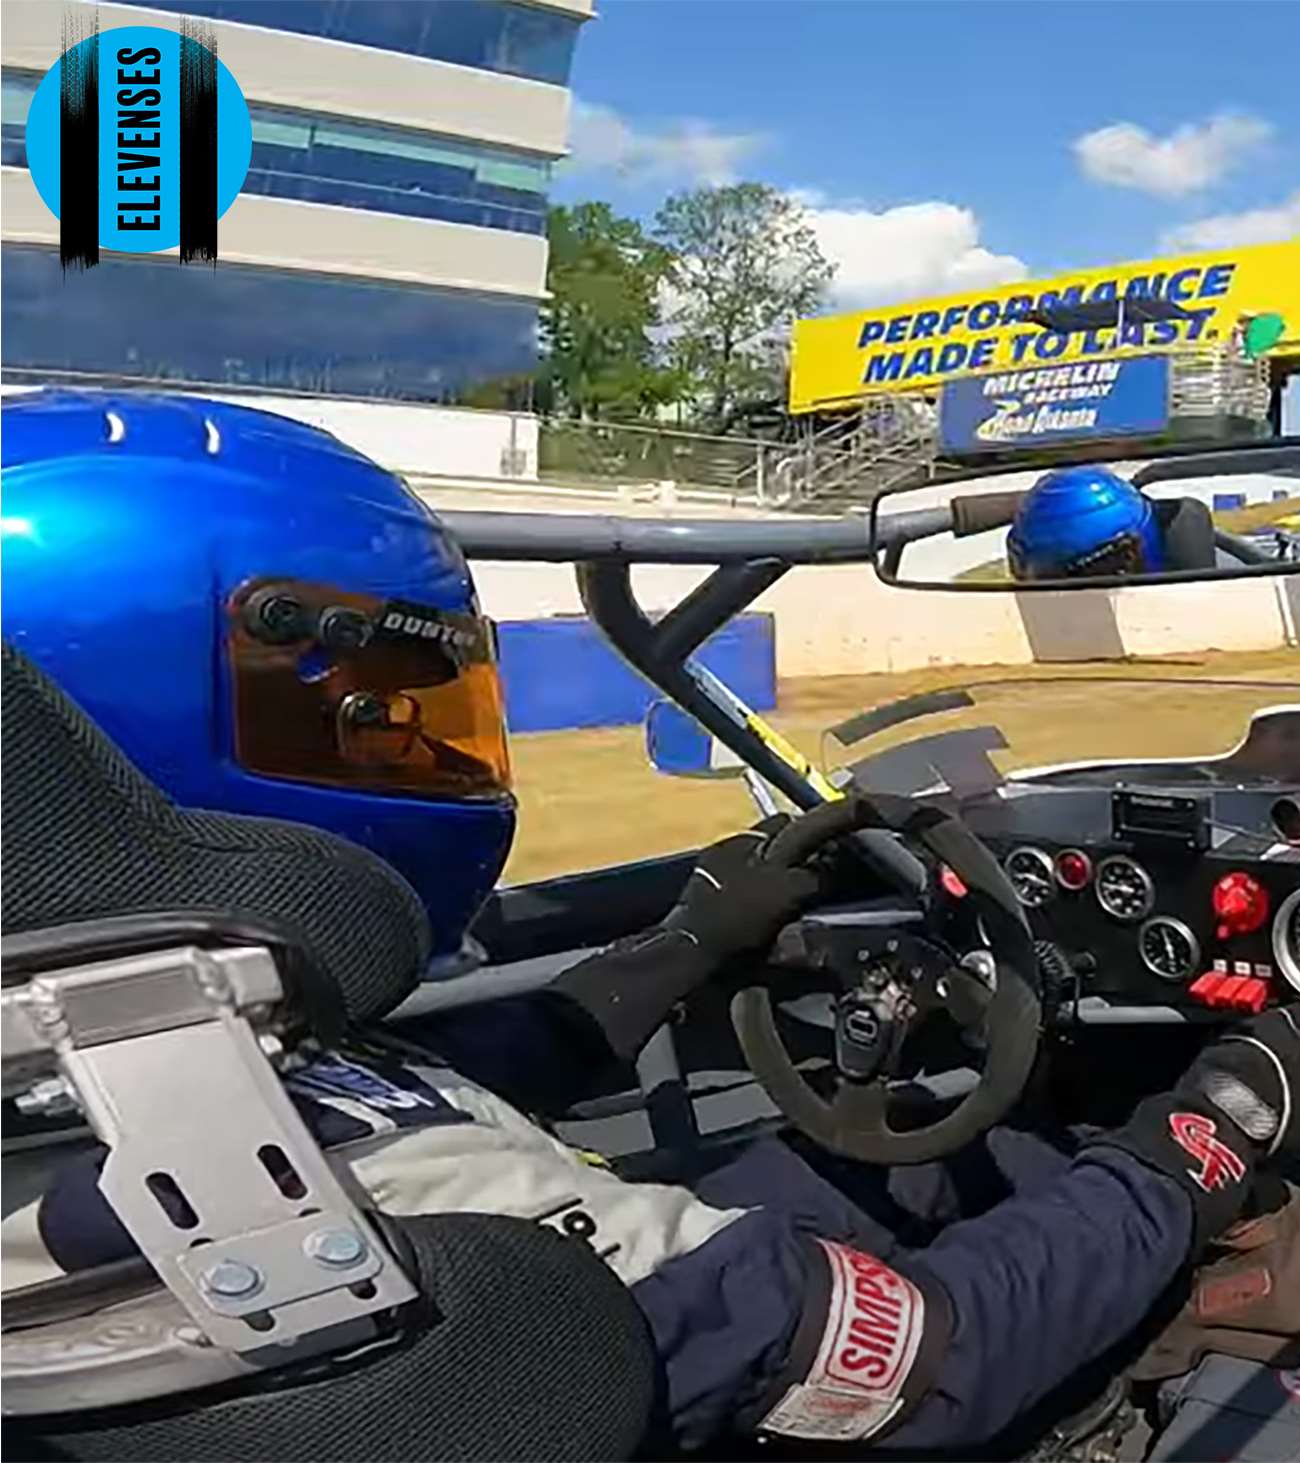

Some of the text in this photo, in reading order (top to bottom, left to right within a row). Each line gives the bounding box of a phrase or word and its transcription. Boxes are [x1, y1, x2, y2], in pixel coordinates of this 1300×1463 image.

[858, 263, 1237, 348] PERFORMANCE
[863, 338, 999, 385] MADE
[1012, 329, 1067, 361] TO
[983, 362, 1121, 396] MICHELIN
